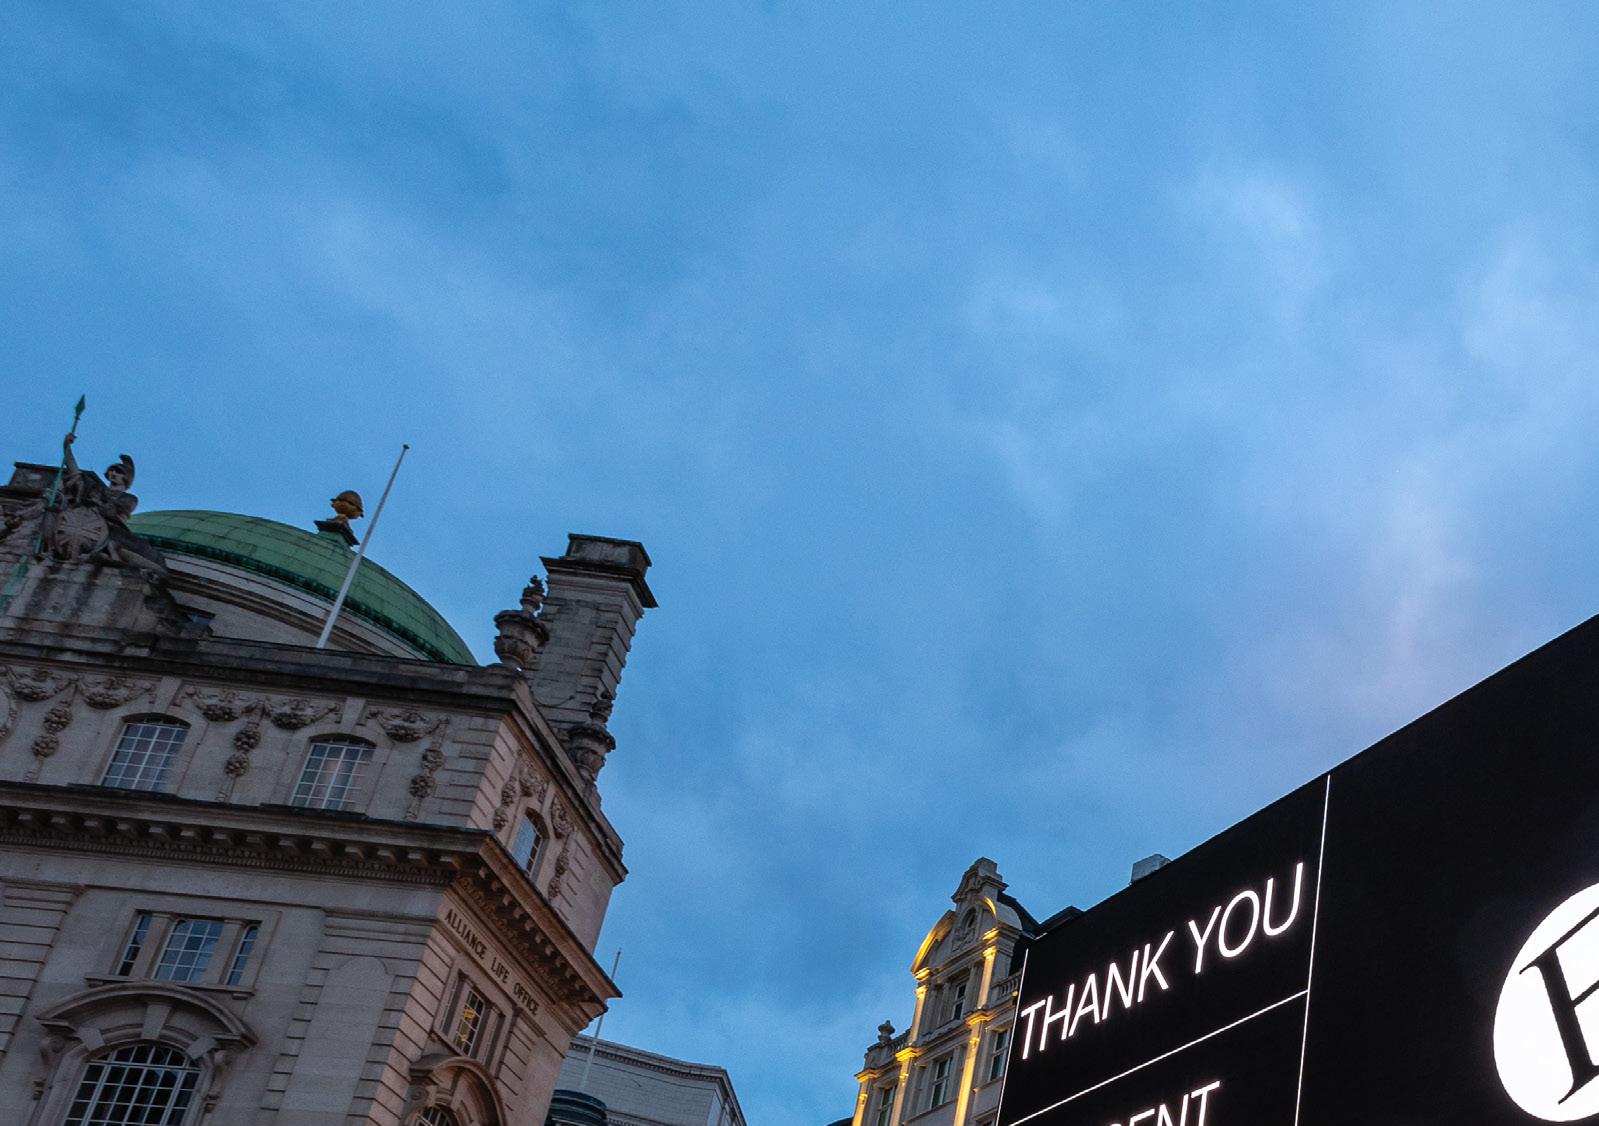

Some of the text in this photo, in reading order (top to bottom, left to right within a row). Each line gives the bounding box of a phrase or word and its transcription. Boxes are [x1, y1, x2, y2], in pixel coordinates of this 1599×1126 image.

[444, 909, 539, 1016] ALLIANCE LIFE OFFICE
[1021, 862, 1303, 1060] THANK YOU
